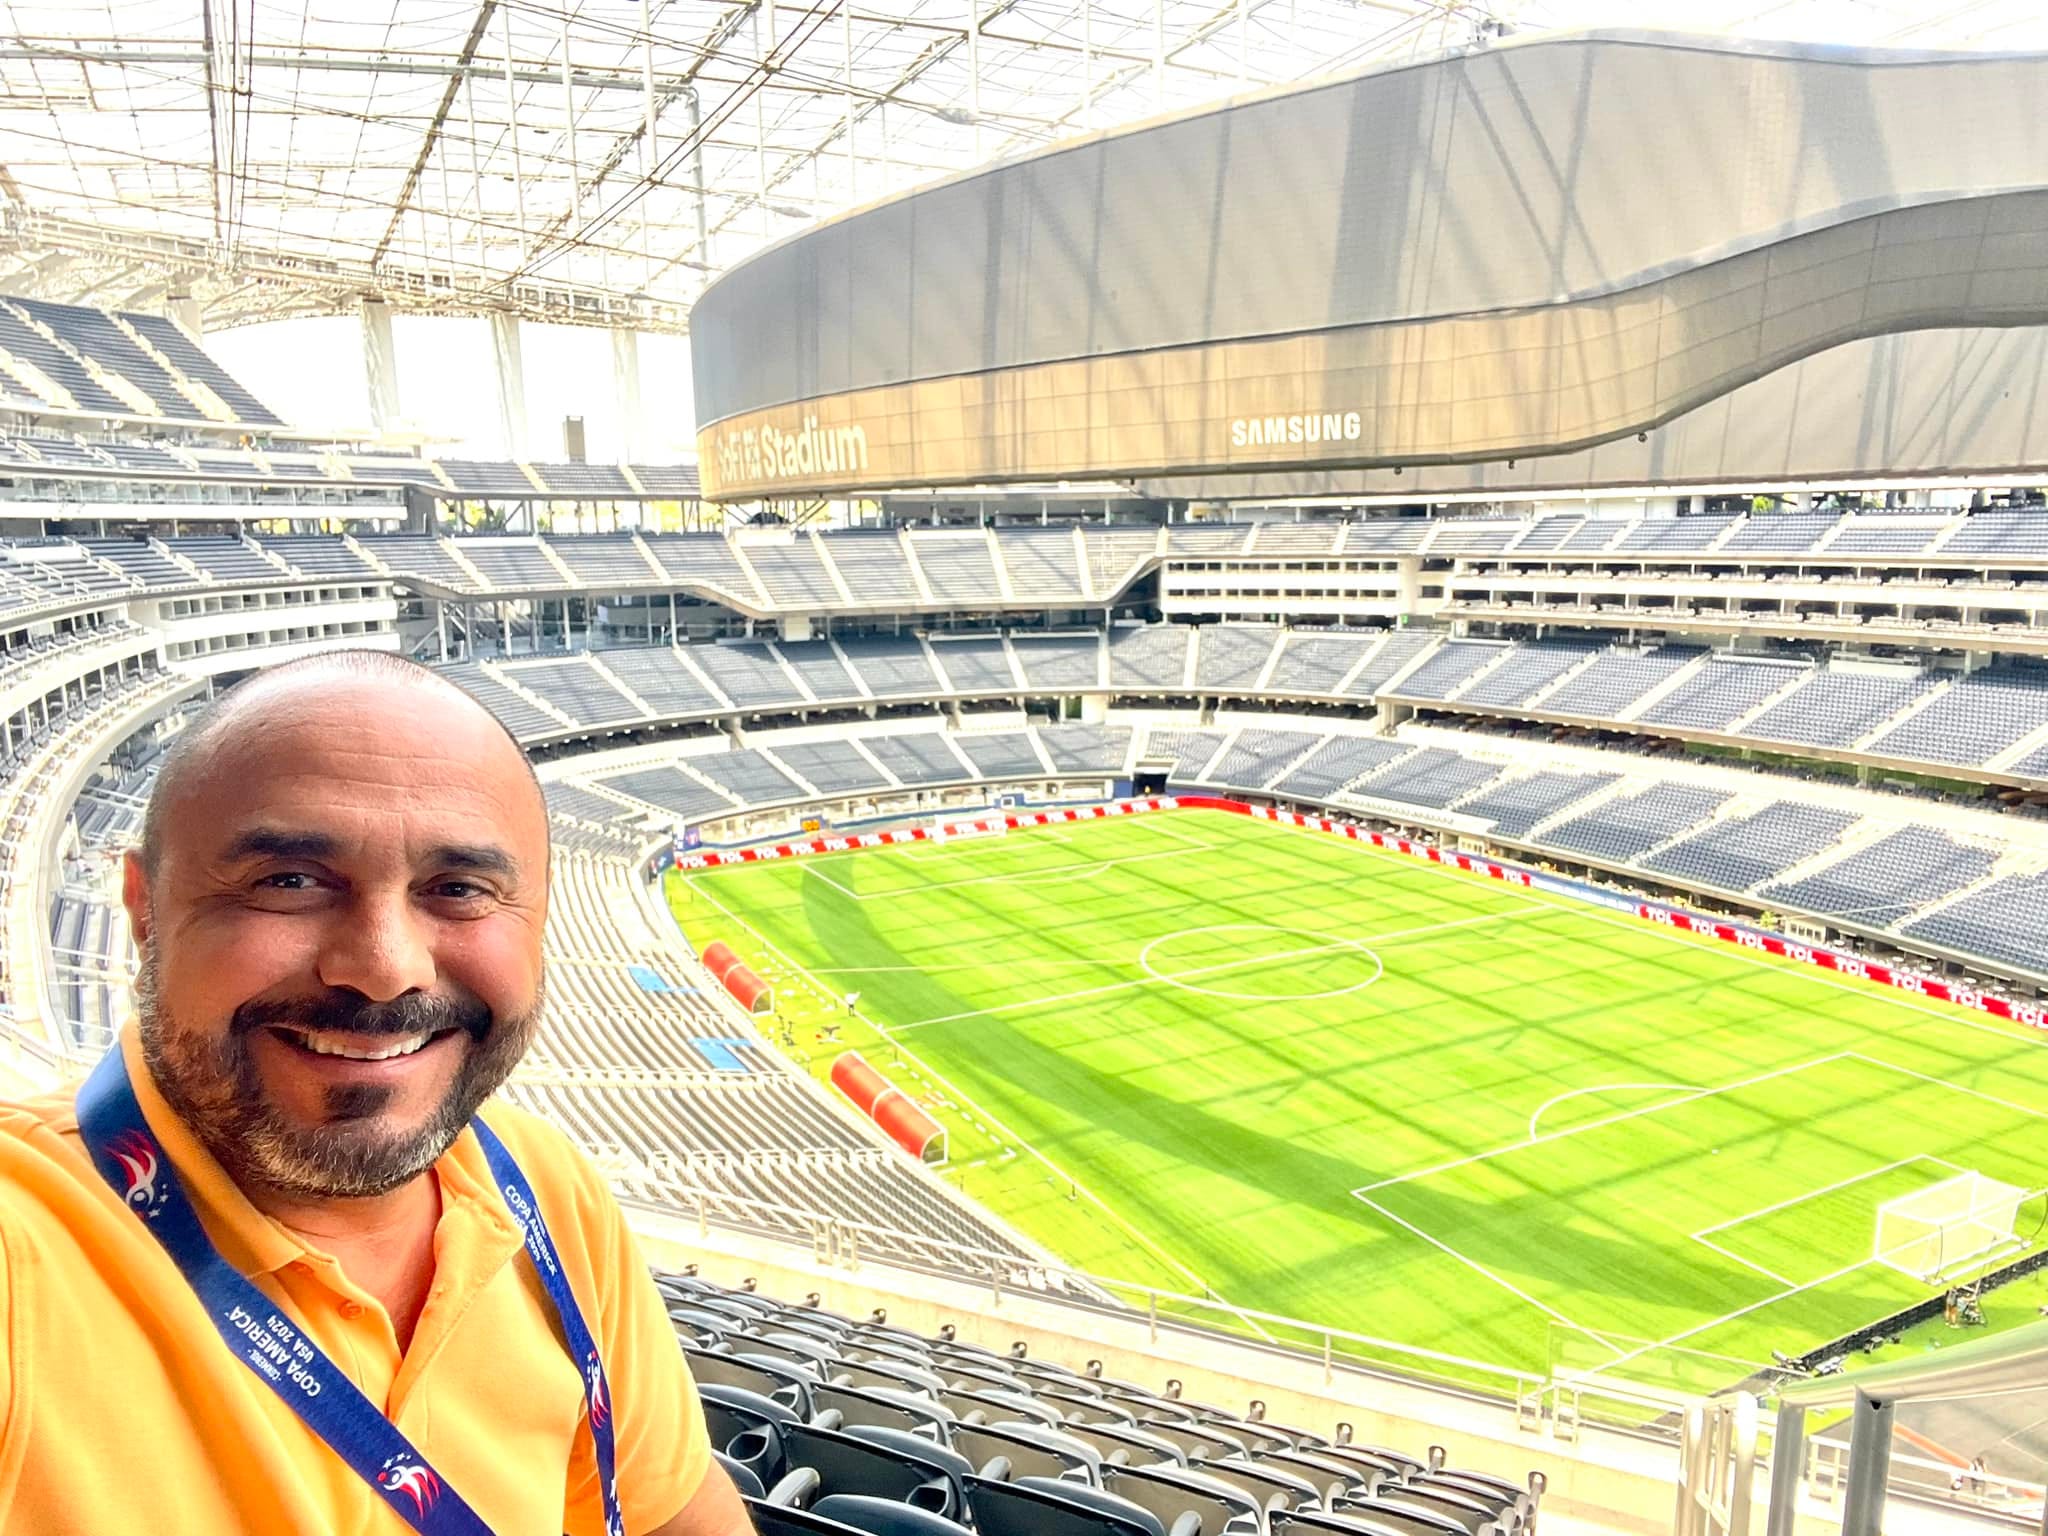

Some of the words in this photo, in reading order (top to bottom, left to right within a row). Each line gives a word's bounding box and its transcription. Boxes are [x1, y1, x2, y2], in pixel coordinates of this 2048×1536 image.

[761, 415, 868, 479] Stadium
[1231, 412, 1361, 447] SAMSUNG
[1647, 906, 1675, 926] TCL
[1689, 917, 1720, 938] TCL
[1734, 929, 1767, 951] TCL
[1782, 943, 1817, 965] TCL
[1834, 956, 1870, 979] TCL
[1889, 971, 1928, 995] TCL
[1947, 987, 1988, 1011] TCL
[505, 1185, 532, 1220] COPA
[528, 1218, 557, 1276] AMERICA
[229, 1306, 292, 1365] AMERICA
[266, 1315, 295, 1343] 2024
[292, 1338, 314, 1363] USA
[286, 1359, 321, 1397] COPA
